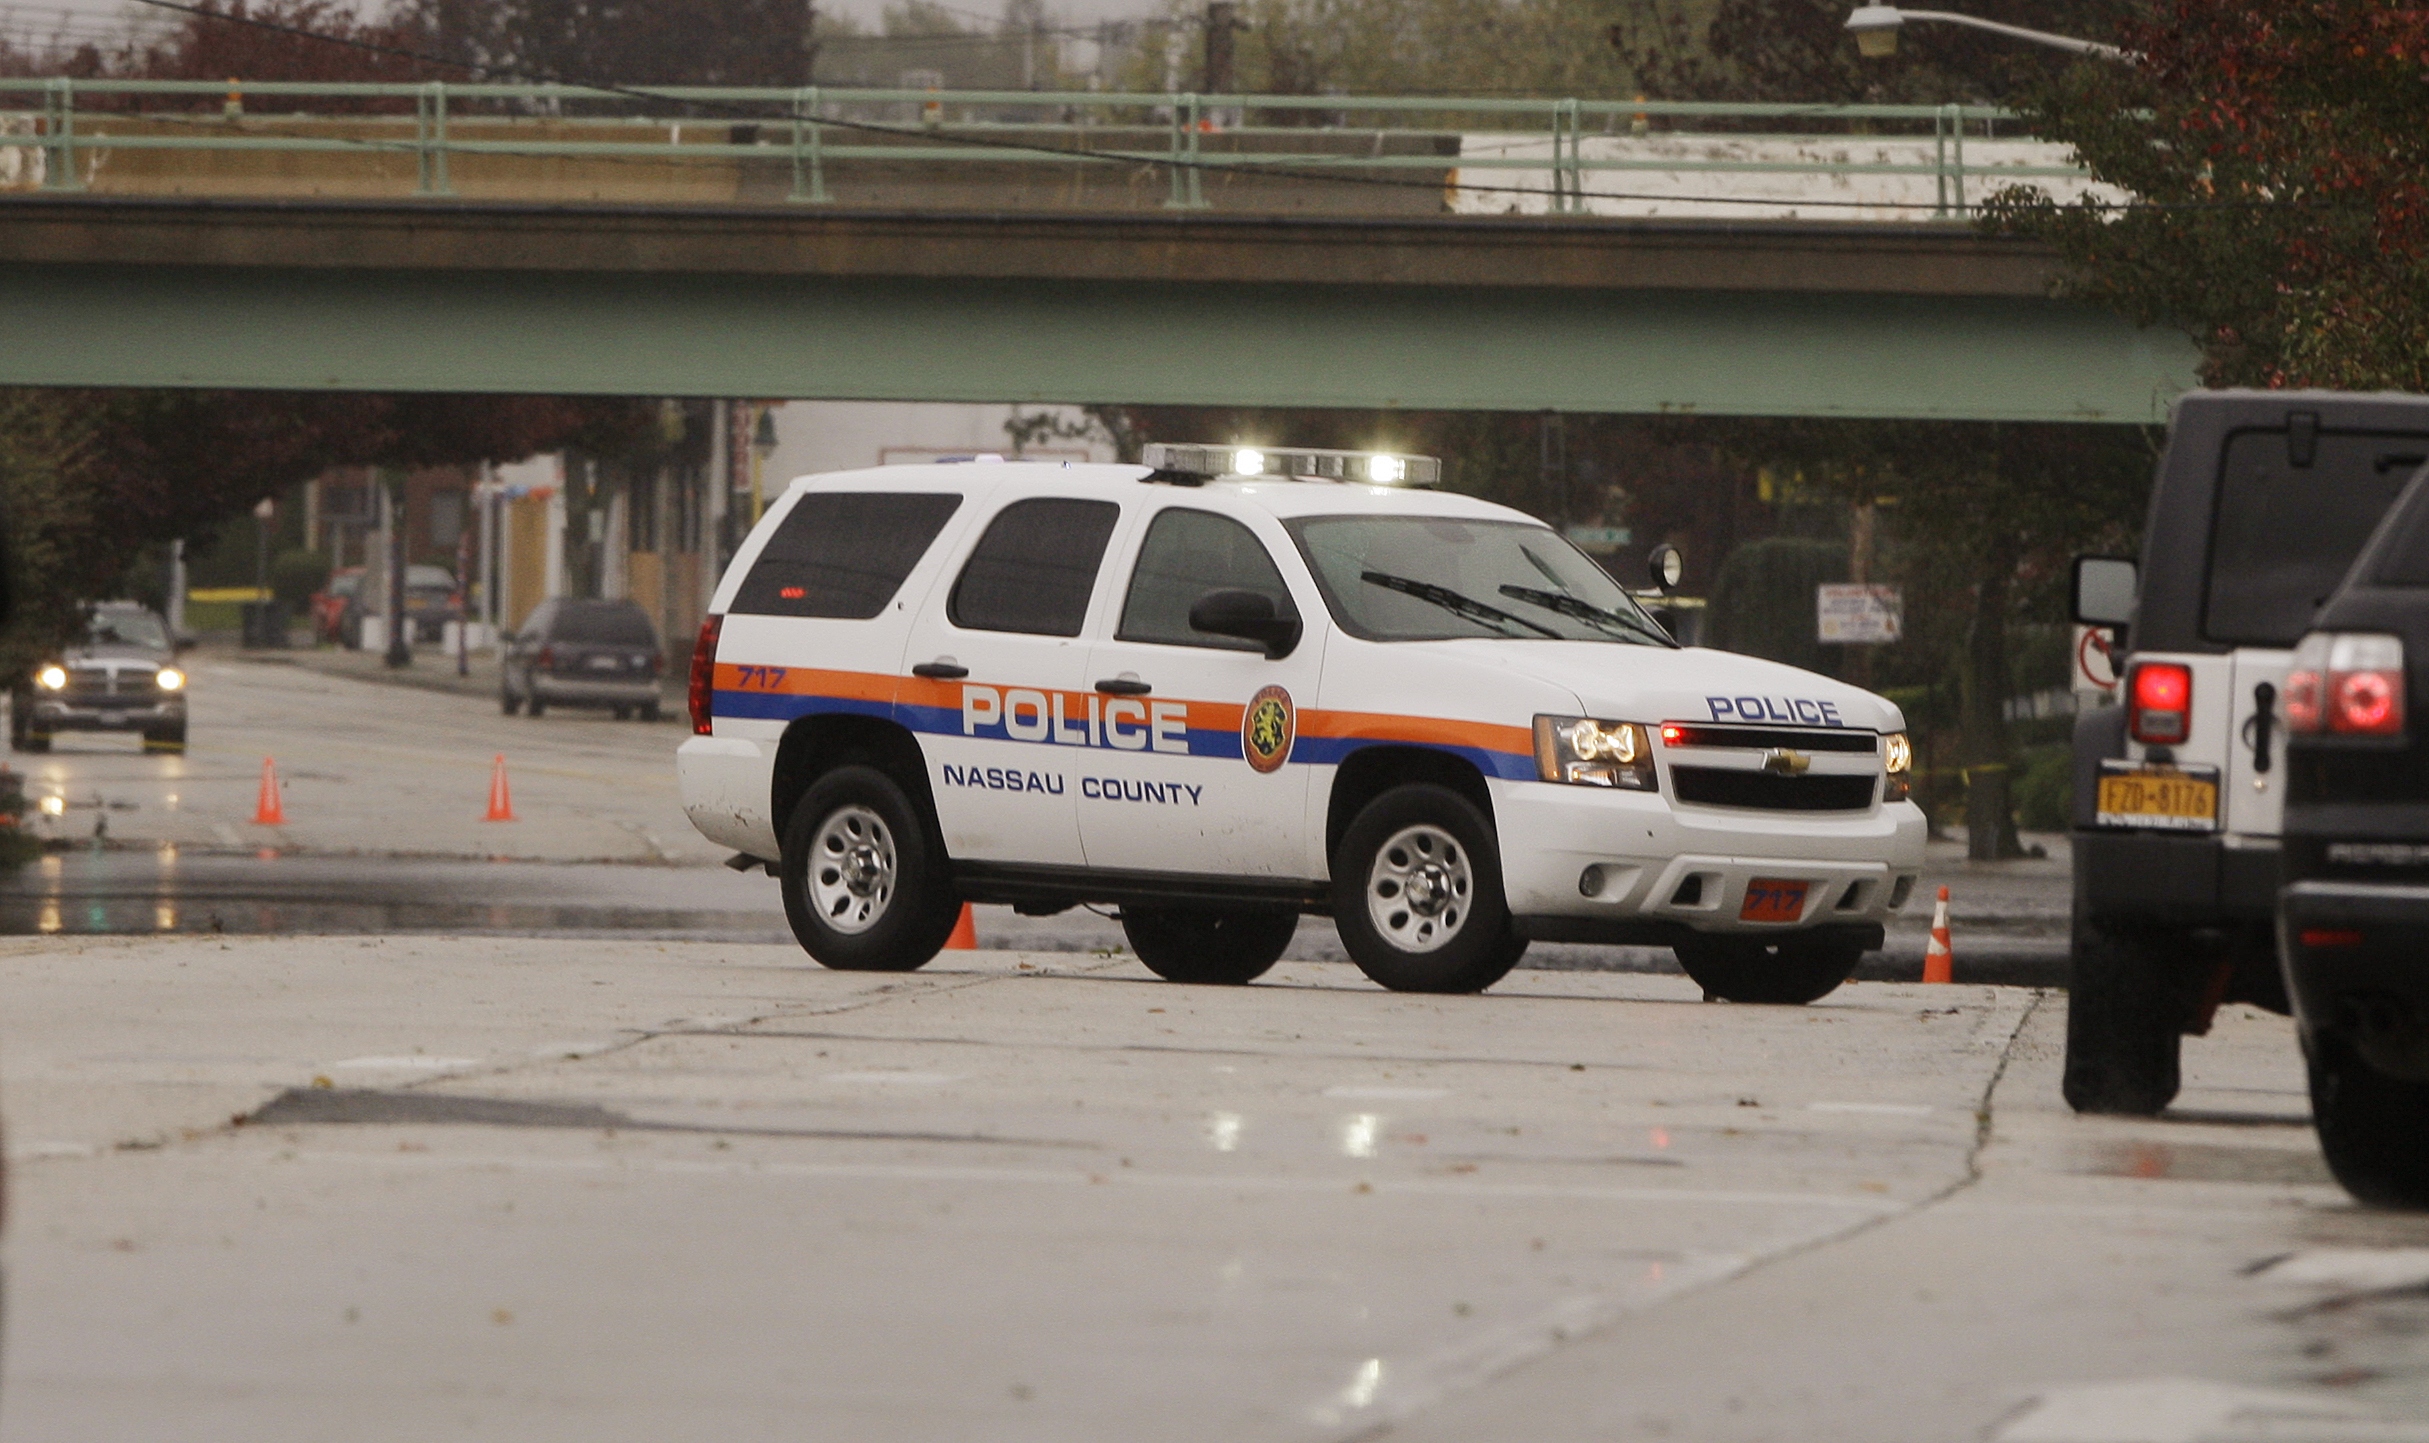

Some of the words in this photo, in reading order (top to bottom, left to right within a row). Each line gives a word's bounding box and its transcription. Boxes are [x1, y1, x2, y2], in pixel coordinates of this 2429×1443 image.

[738, 665, 786, 688] 717
[962, 684, 1190, 754] POLICE
[1705, 696, 1844, 727] POLICE
[943, 763, 1065, 795] NASSAU
[1082, 776, 1203, 806] COUNTY
[1747, 889, 1804, 911] 717
